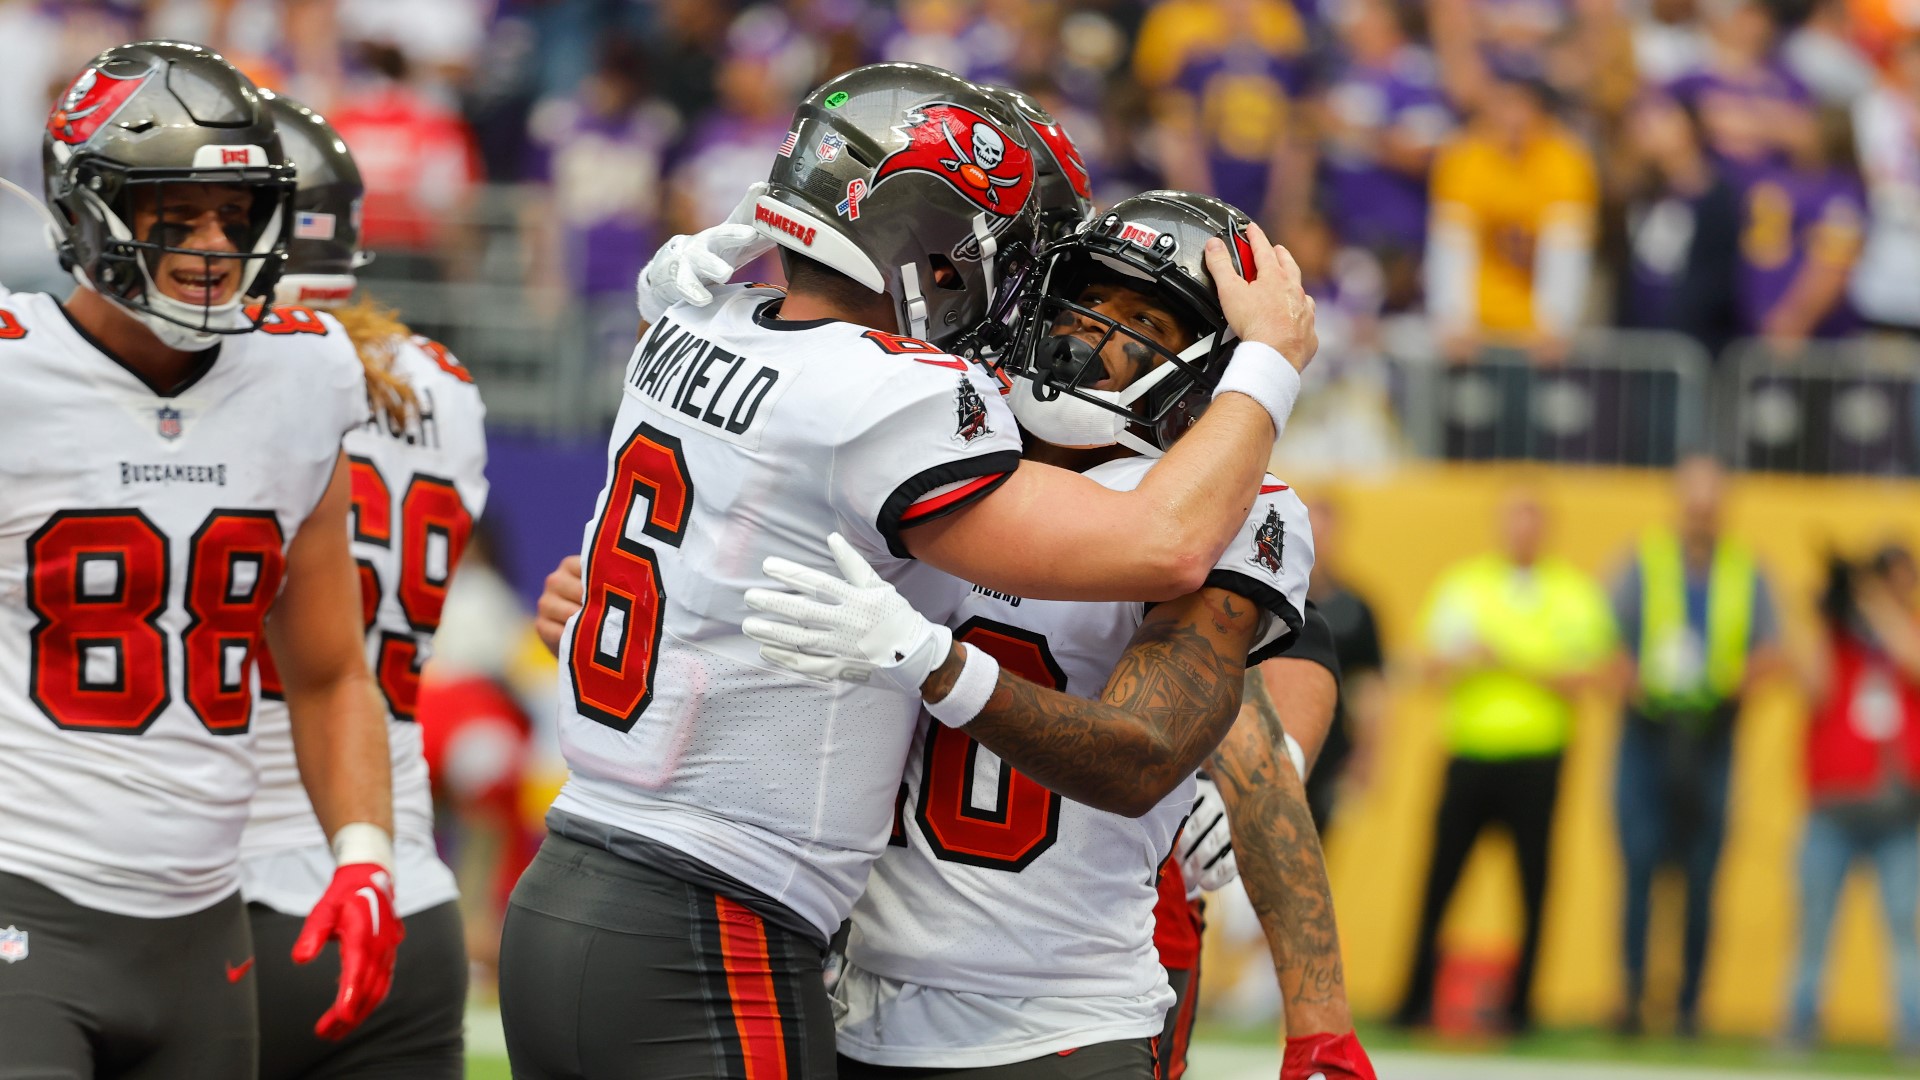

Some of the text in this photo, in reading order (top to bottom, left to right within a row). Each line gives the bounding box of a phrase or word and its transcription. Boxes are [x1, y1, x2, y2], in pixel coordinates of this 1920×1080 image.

[1121, 225, 1157, 247] BUCS
[629, 315, 779, 436] MAYFIELD
[119, 461, 227, 486] BUCCANEERS
[26, 507, 285, 736] 88
[568, 421, 694, 733] 6
[888, 614, 1068, 873] 0
